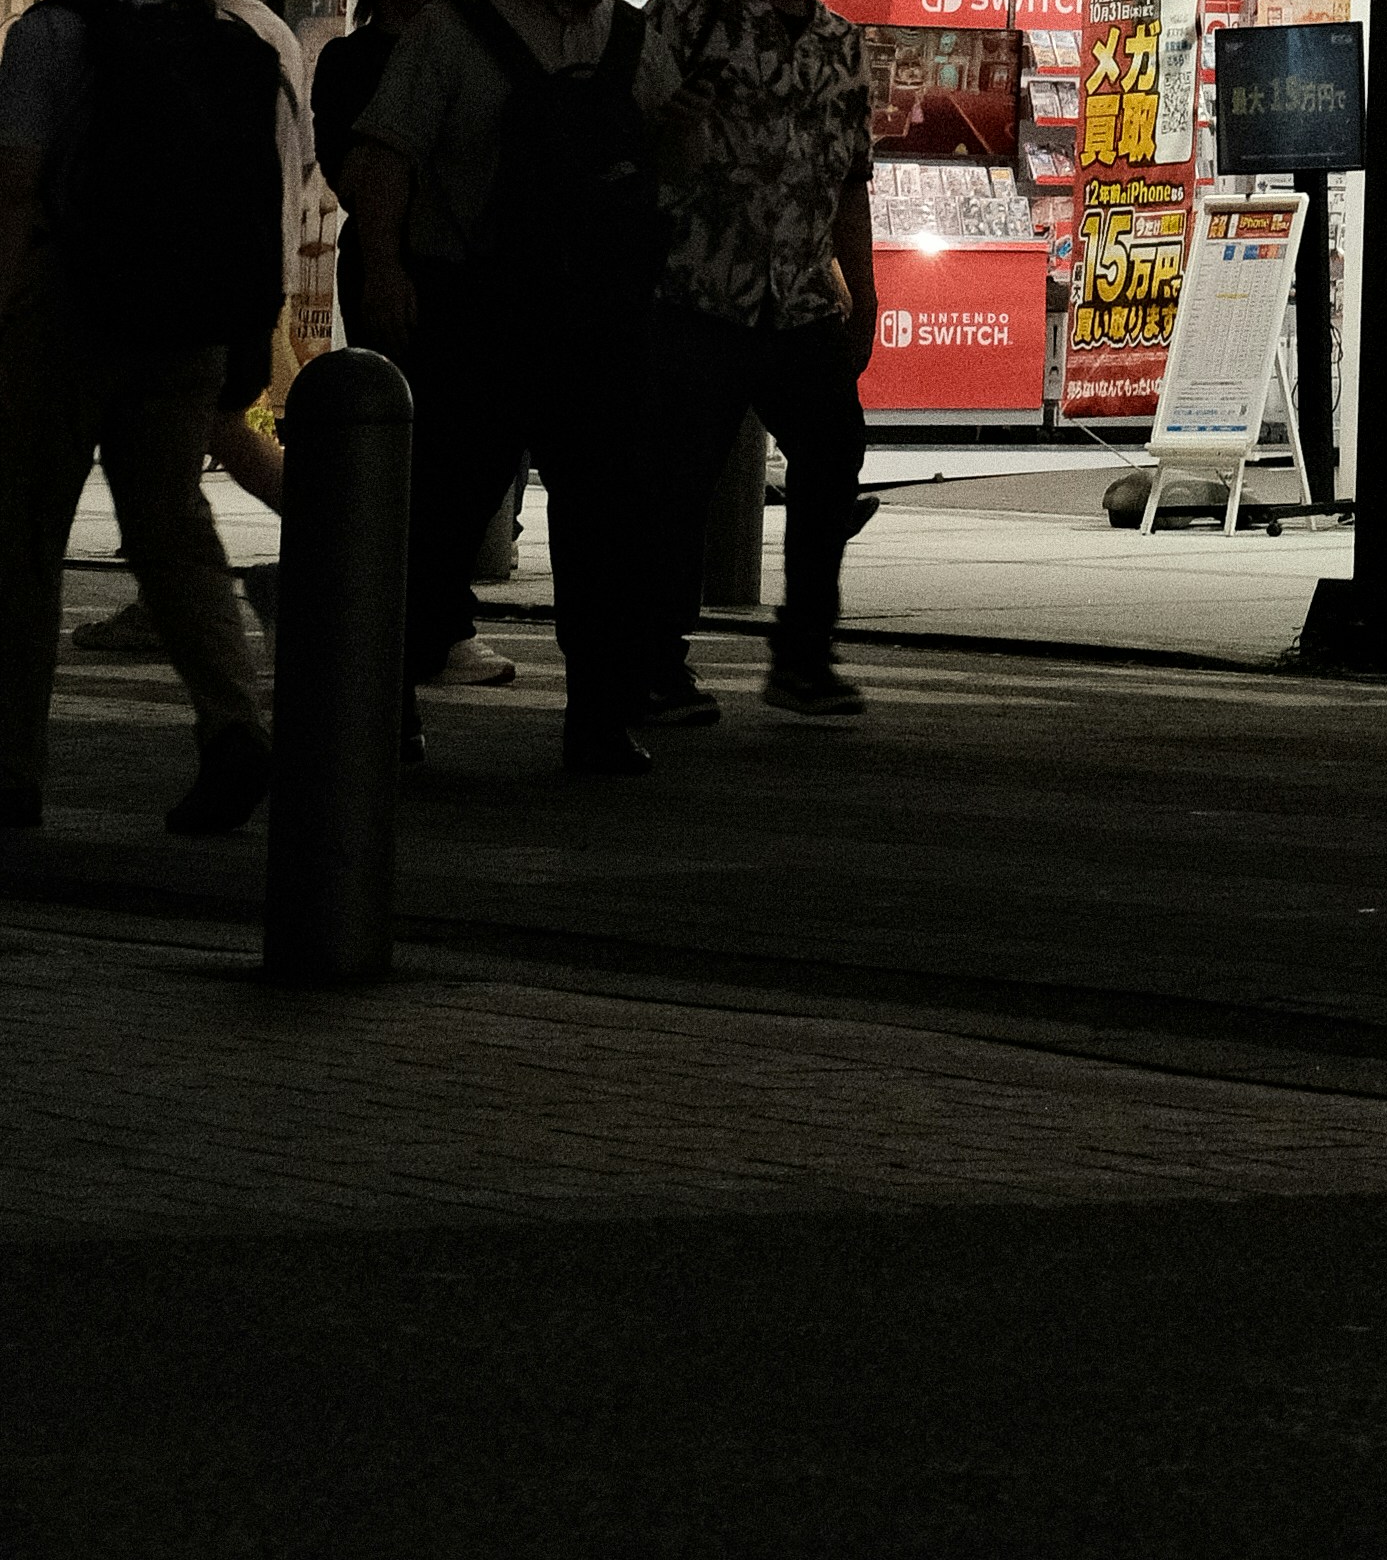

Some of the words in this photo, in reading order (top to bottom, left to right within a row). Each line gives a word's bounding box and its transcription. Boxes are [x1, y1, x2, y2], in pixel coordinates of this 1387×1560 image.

[1086, 21, 1161, 93] メガ
[1081, 96, 1159, 166] 買取
[918, 312, 1009, 325] NINTENDO
[918, 325, 1010, 347] SWITCH
